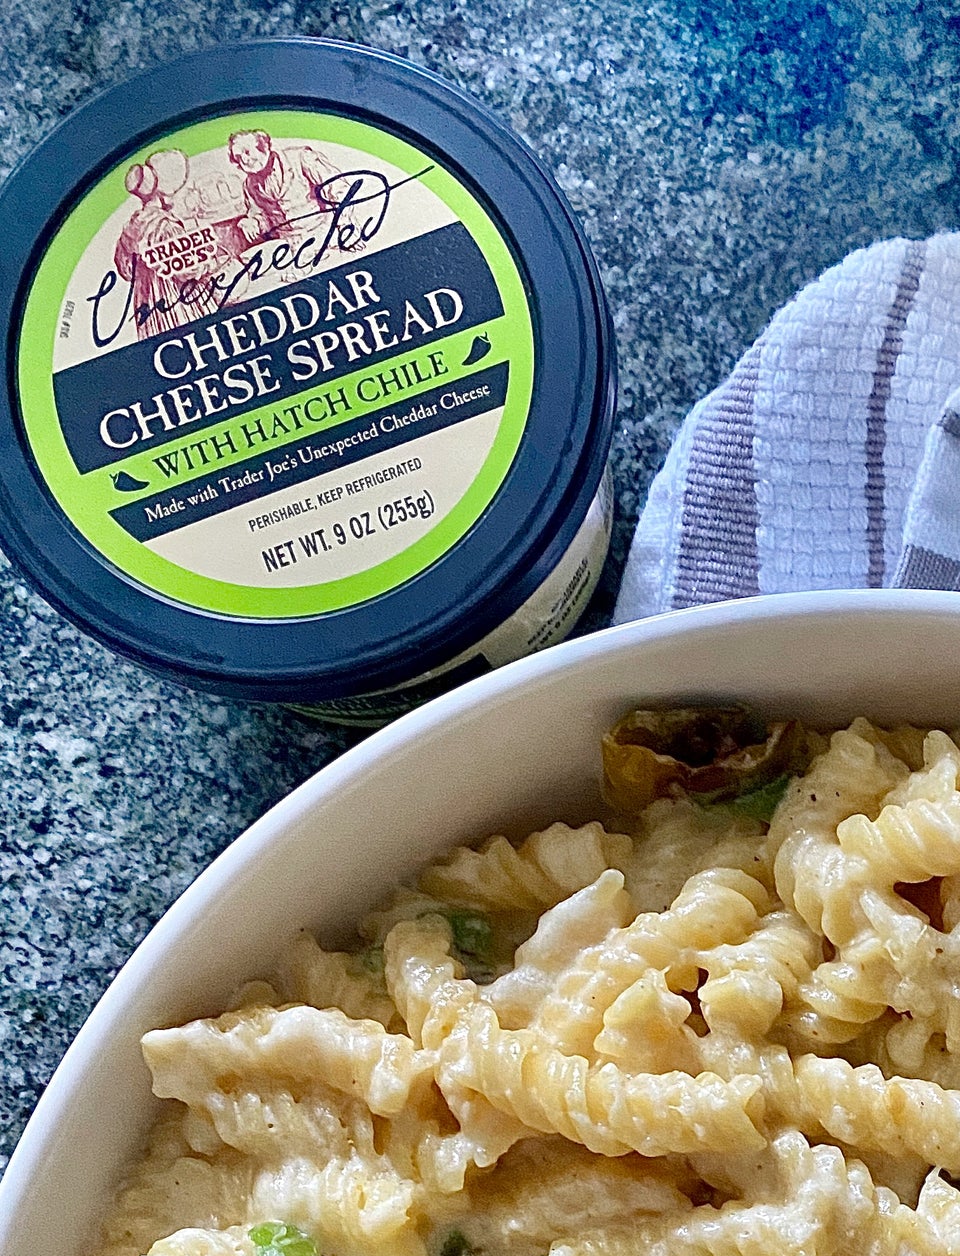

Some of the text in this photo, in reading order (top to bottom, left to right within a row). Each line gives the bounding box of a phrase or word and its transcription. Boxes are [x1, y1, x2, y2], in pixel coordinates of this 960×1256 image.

[87, 166, 434, 347] Unexpected
[144, 229, 215, 265] TRADER
[100, 287, 464, 449] CHEESE SPREAD
[154, 270, 380, 380] CHEDDAR
[144, 384, 491, 523] Made with Trader Joe's Unexpected Cheddar Cheese
[153, 351, 449, 480] WITH HATCH CHILE
[248, 457, 423, 532] PERISHABLE, KEEP REFRIGERATED
[261, 489, 436, 573] NET WT. 9 OZ (255g)
